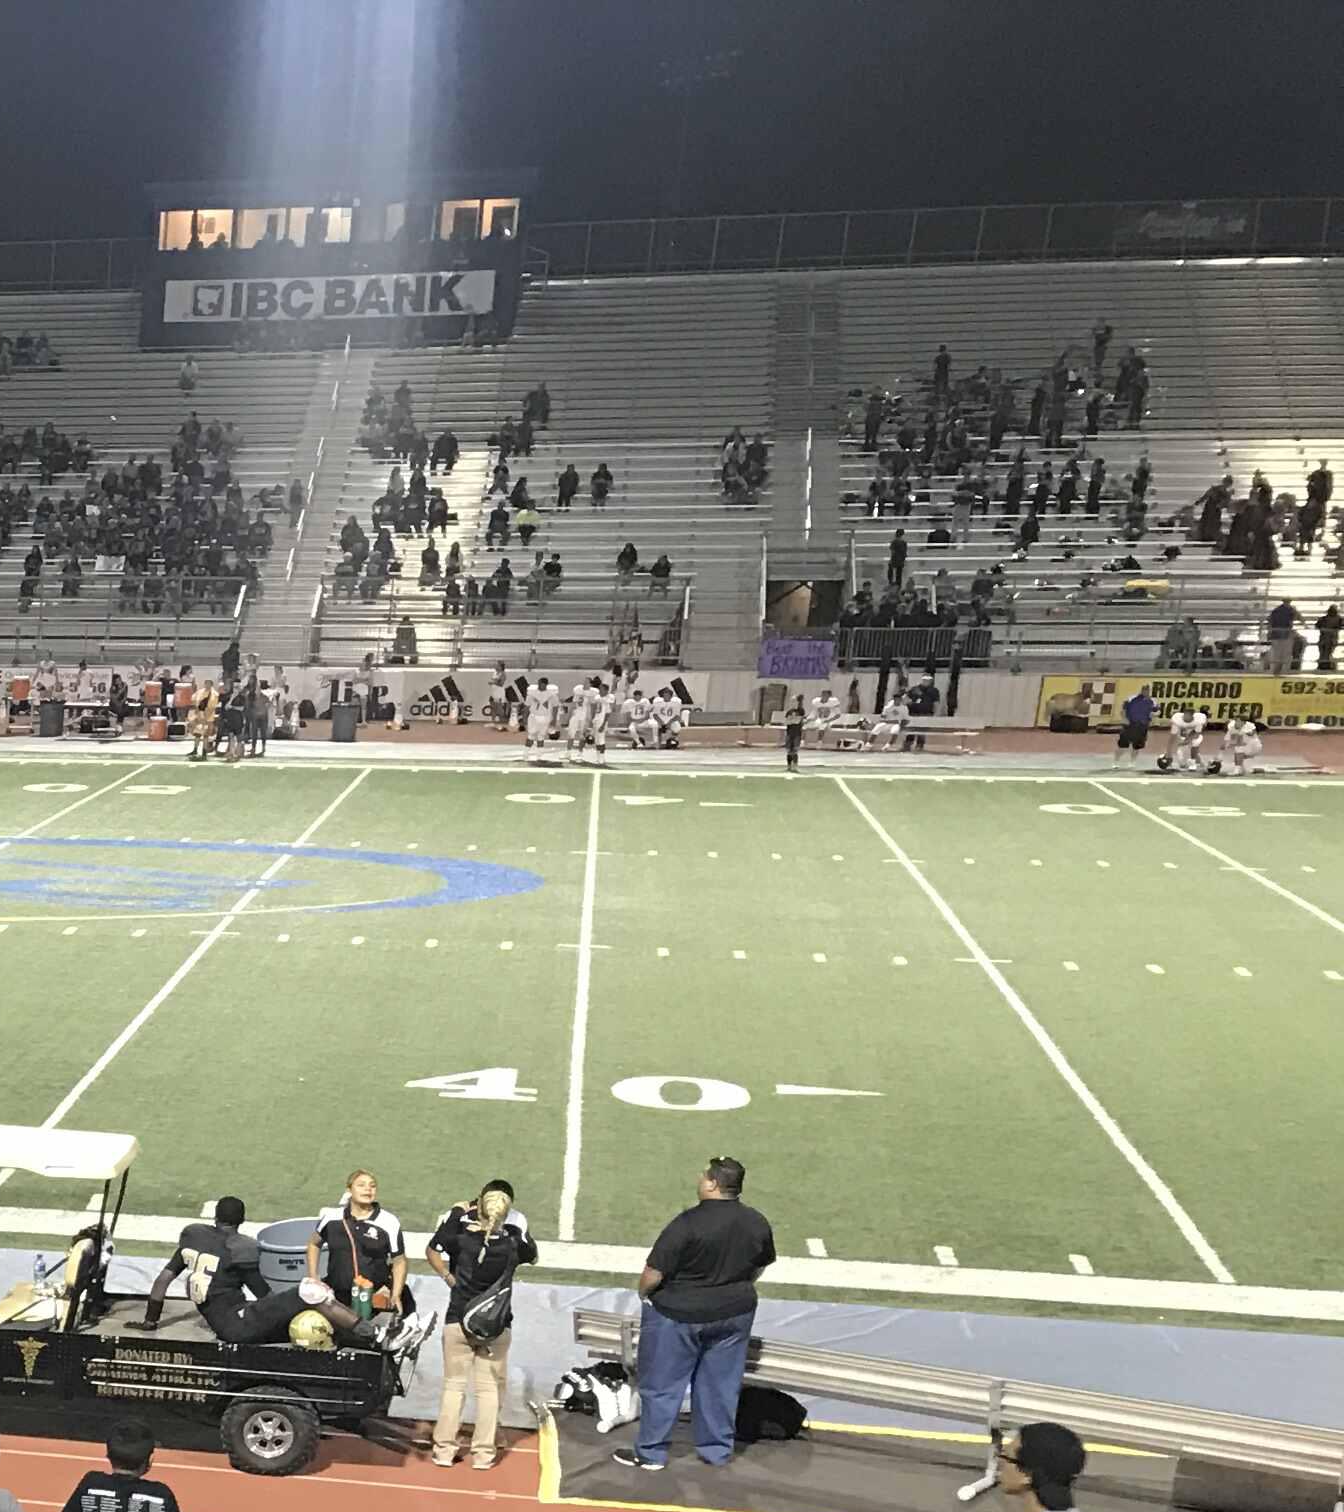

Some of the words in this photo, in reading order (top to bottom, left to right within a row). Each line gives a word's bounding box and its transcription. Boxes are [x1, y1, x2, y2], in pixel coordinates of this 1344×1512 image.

[230, 282, 314, 319] IBC
[323, 274, 466, 315] BANK
[1151, 681, 1243, 699] RICARDO
[411, 703, 473, 717] adids
[1217, 702, 1263, 720] FEED
[1267, 715, 1300, 727] GO
[115, 1348, 171, 1363] DONATED
